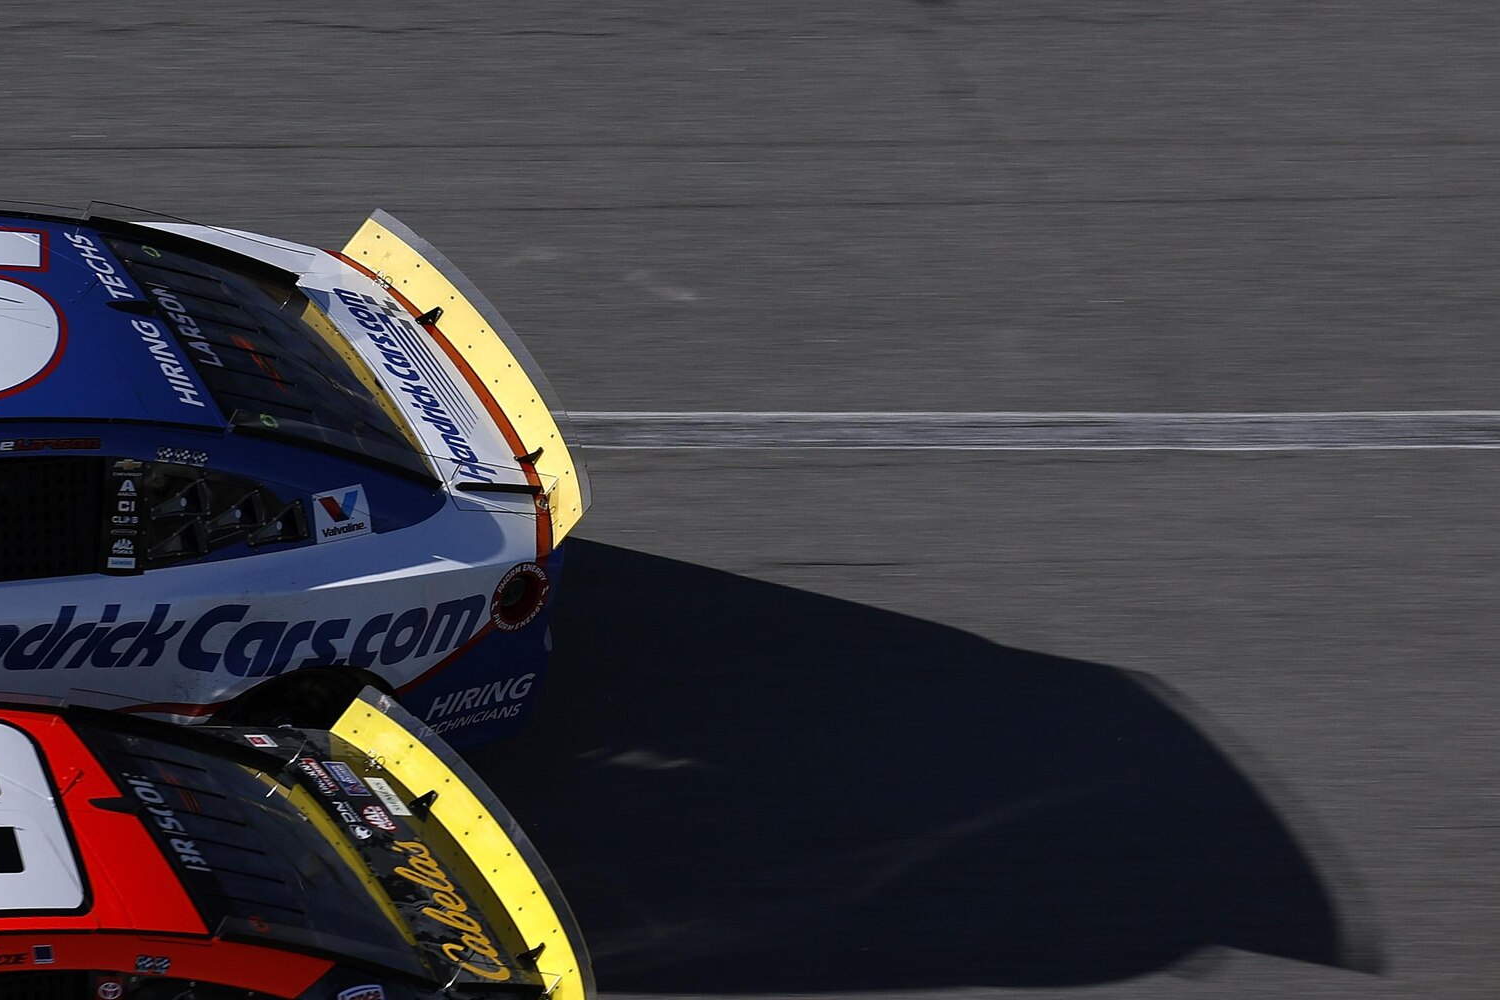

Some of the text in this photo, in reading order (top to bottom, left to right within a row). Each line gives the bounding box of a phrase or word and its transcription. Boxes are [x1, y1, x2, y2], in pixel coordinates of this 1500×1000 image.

[64, 232, 205, 407] HIRING TECHS
[145, 281, 224, 367] LARSON
[322, 522, 365, 537] Valvoline
[522, 563, 547, 581] ENERGY
[419, 703, 523, 738] TECHNICIANS
[425, 673, 536, 721] HIRING
[392, 840, 512, 981] Cabela's
